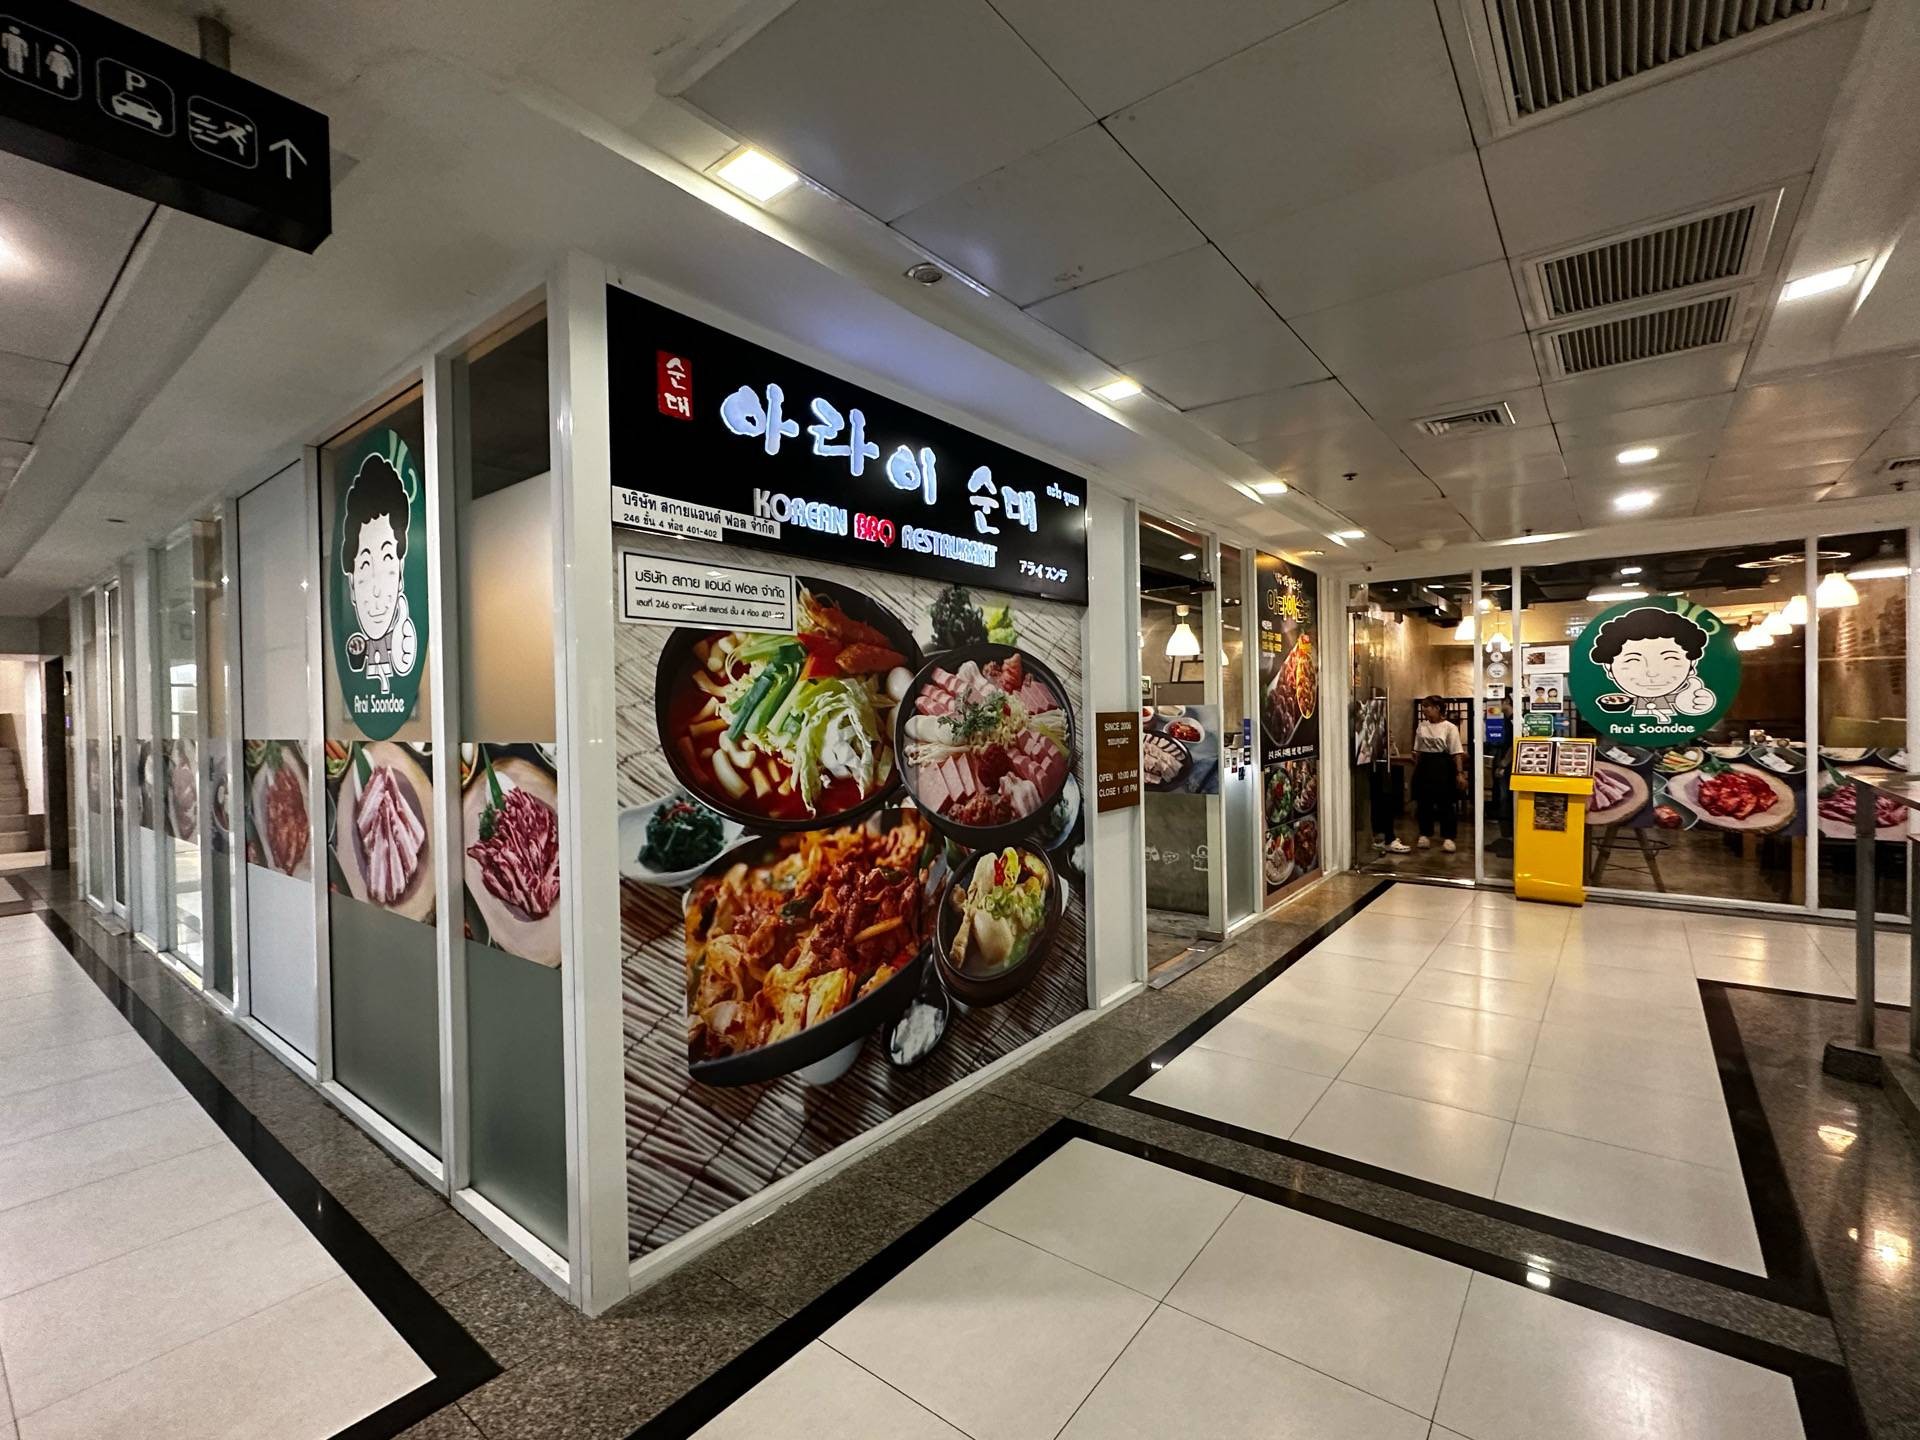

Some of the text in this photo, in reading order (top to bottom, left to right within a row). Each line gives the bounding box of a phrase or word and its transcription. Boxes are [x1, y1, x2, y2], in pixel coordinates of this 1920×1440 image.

[125, 70, 147, 92] P
[665, 357, 692, 417] 순대
[719, 382, 1039, 536] 아라이 순대
[622, 490, 657, 512] บริษัท
[623, 513, 640, 525] 246
[658, 521, 664, 529] 4
[686, 525, 718, 539] 401-402
[752, 487, 999, 568] KOREAN BBQ RESTAURANT
[635, 569, 668, 585] บริษัท
[671, 574, 700, 588] สกาย
[735, 582, 758, 596] ฟอล
[655, 599, 670, 609] 246
[354, 693, 405, 713] Arai Soondae
[1104, 721, 1120, 732] SINCE
[1609, 722, 1696, 734] Arai Soondae
[1098, 772, 1114, 783] OPEN
[1098, 786, 1116, 798] CLOSE
